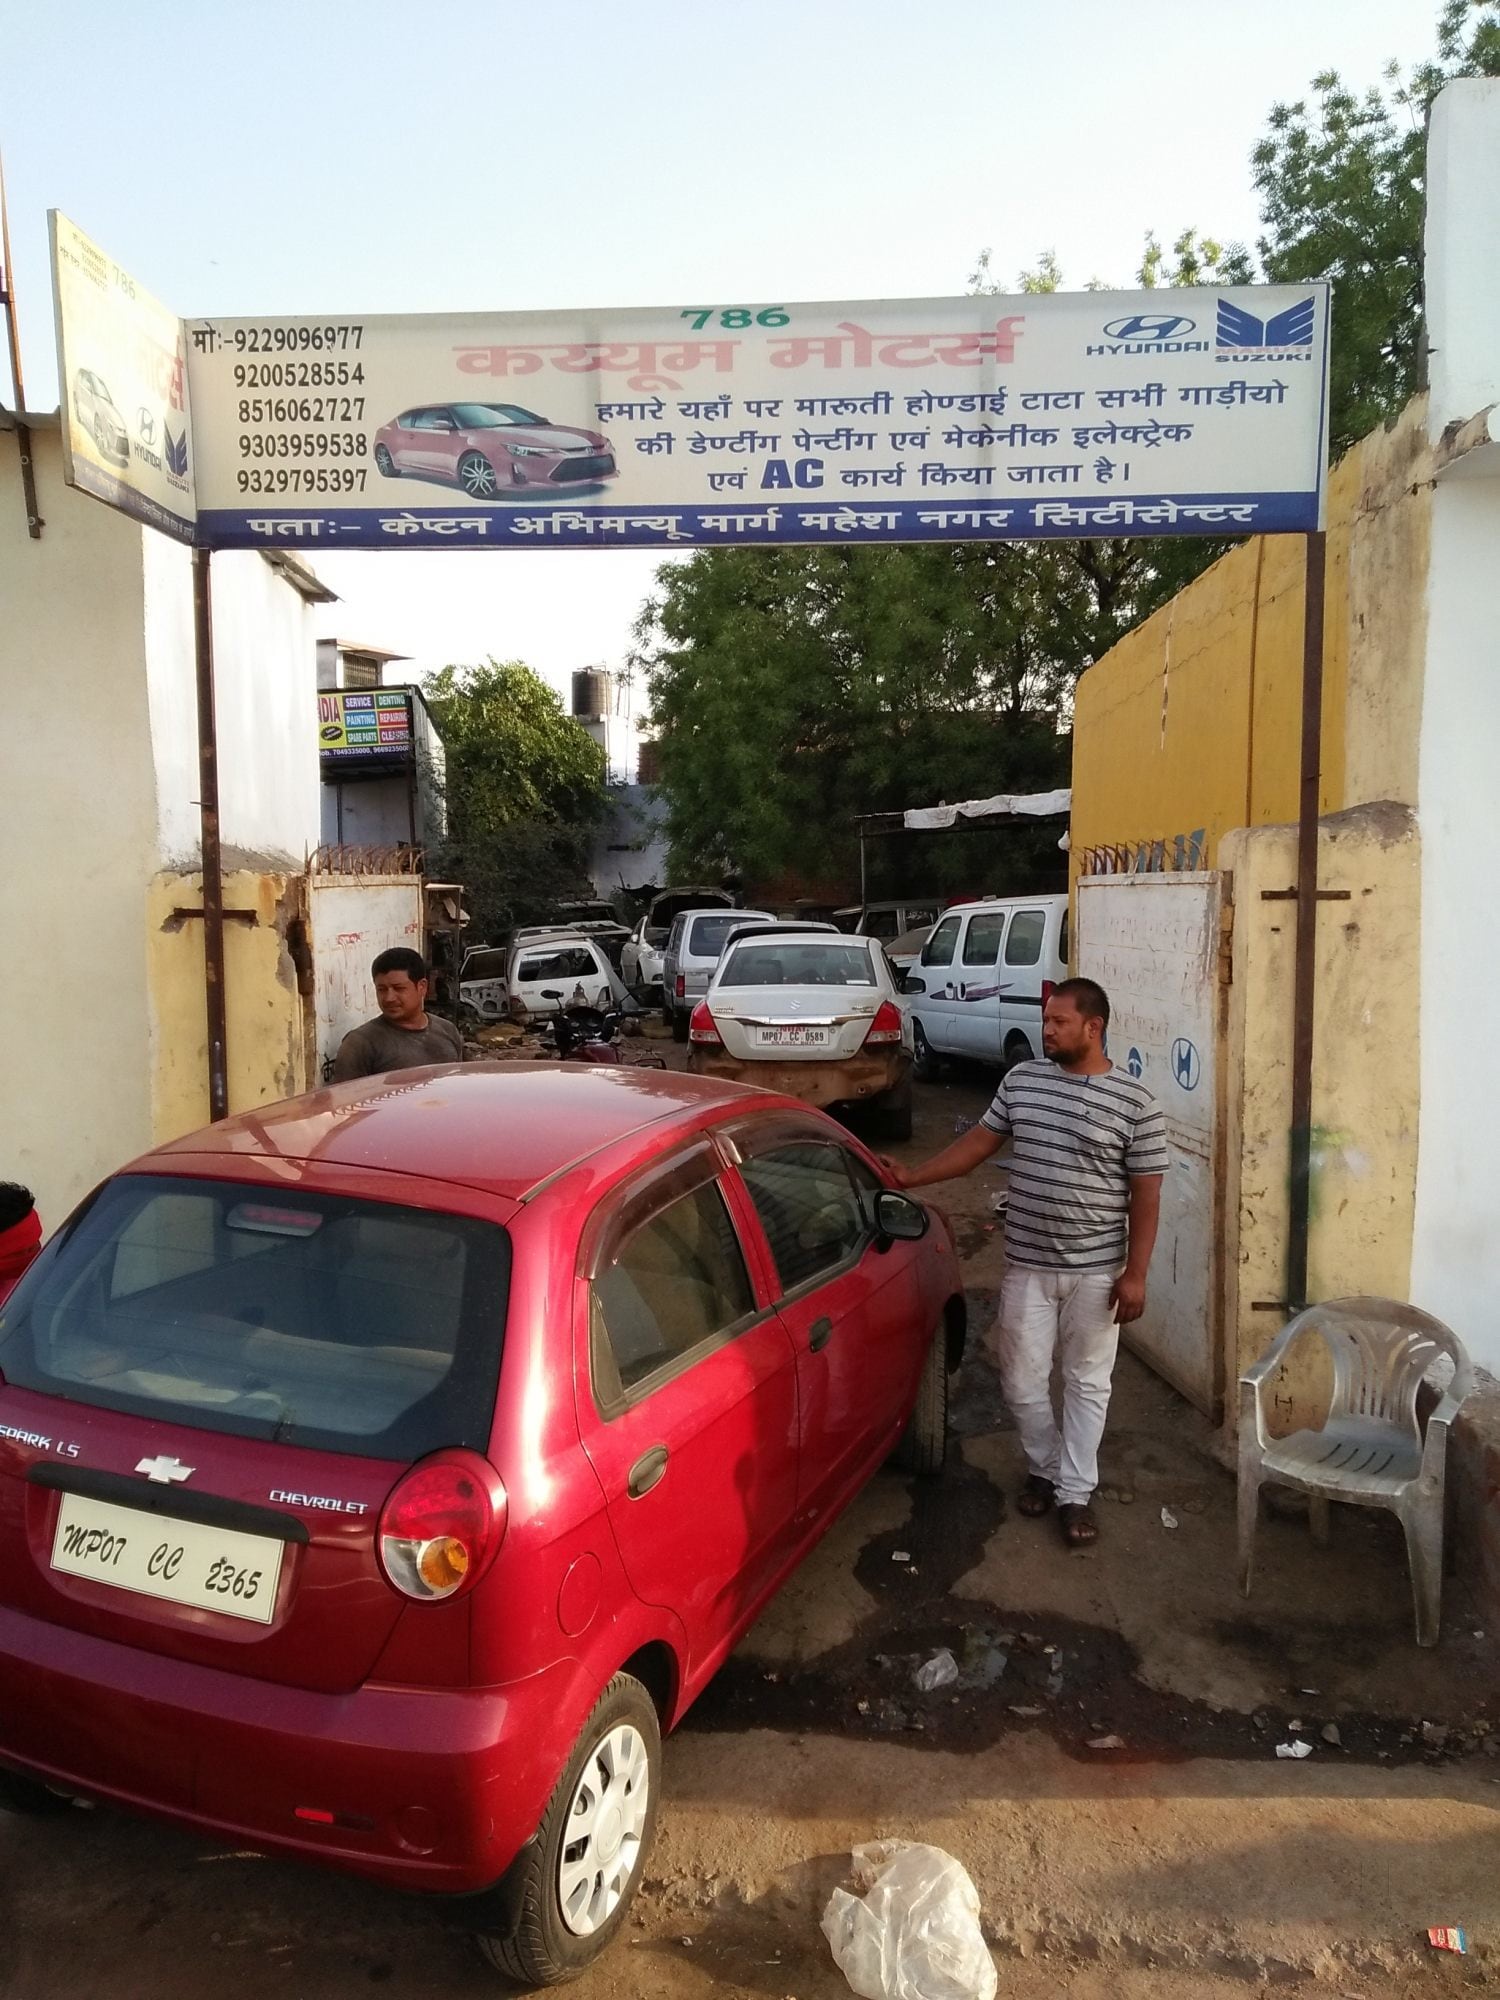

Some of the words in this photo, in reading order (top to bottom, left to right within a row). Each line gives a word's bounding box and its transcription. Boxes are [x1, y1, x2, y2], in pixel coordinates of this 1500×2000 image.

[112, 264, 135, 300] 786
[681, 307, 790, 330] 786
[767, 316, 1025, 368] मोटर्स
[1087, 341, 1209, 356] HYUNDAI
[1215, 353, 1312, 363] SUZUKI
[234, 362, 365, 388] 9200528554
[238, 397, 365, 423] 8516062727
[594, 396, 666, 423] हमारे
[677, 395, 733, 421] यहाँ
[744, 400, 783, 417] पर
[794, 391, 894, 416] मारूती
[904, 385, 1008, 415] होण्डाई
[1020, 391, 1085, 410] टाटा
[1096, 383, 1167, 408] सभी
[1179, 379, 1289, 409] गाड़ीयो
[239, 433, 368, 458] 9303959538
[636, 432, 676, 454] की
[890, 426, 930, 450] एवं
[942, 423, 1059, 448] मेकेनीक
[237, 469, 368, 493] 9329795397
[707, 467, 748, 491] एवं
[760, 458, 824, 489] AC
[840, 462, 906, 487] कार्य
[918, 462, 996, 486] किया
[1007, 464, 1083, 484] जाता
[379, 513, 492, 536] केप्टन
[509, 511, 694, 540] अभिमन्यू
[698, 507, 782, 532] मार्ग
[799, 507, 902, 533] महेश
[917, 510, 1014, 529] नगर
[1029, 500, 1258, 528] सिटीसेन्टर
[345, 696, 372, 707] SERVICE
[346, 714, 376, 726] PAINTING
[762, 1032, 783, 1041] MP07
[789, 1032, 800, 1041] CC
[805, 1032, 824, 1041] 0589
[0, 1425, 52, 1450] SPARK
[56, 1441, 81, 1458] LS
[269, 1489, 368, 1515] CHEVROLET
[63, 1524, 127, 1566] MP07
[147, 1543, 184, 1580] CC
[204, 1560, 262, 1600] 2365
